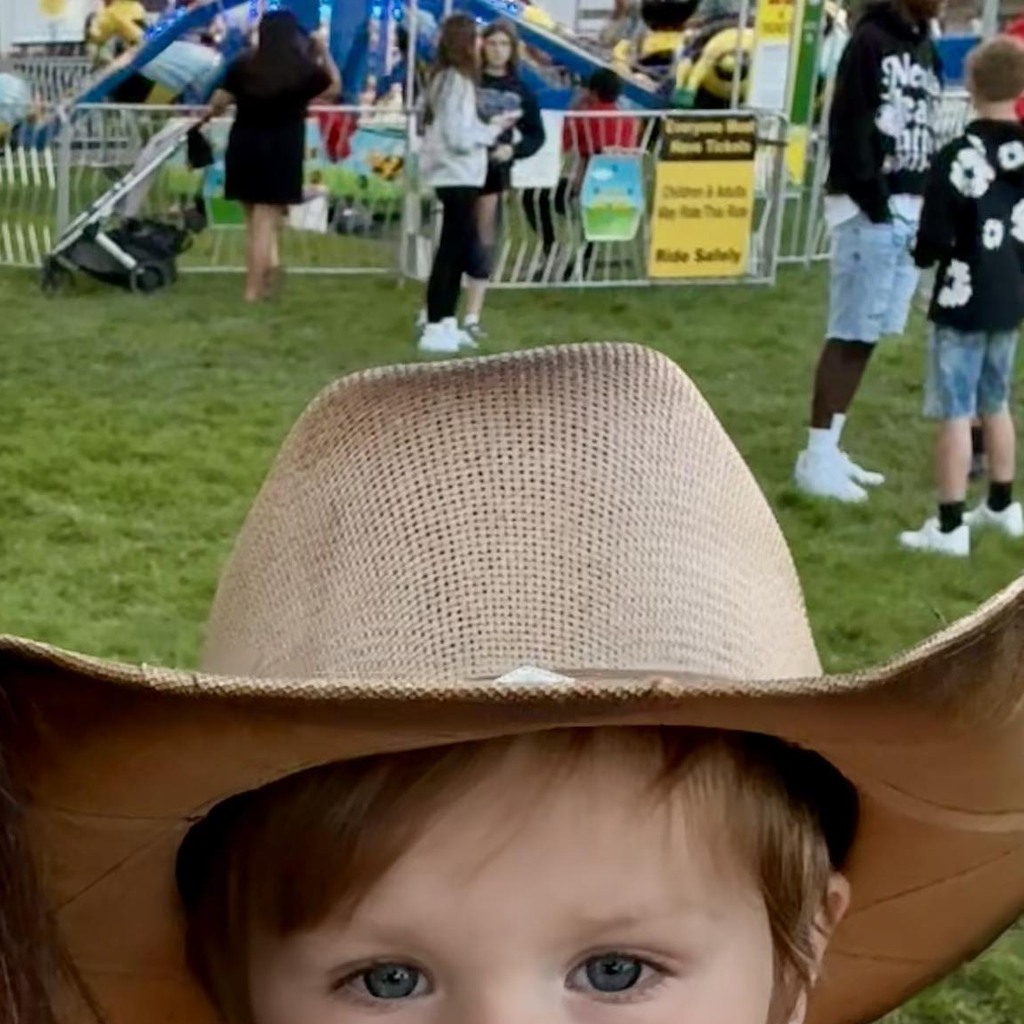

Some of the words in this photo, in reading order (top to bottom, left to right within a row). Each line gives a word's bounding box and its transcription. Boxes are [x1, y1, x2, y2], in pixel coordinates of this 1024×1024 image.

[705, 139, 751, 154] Tickets
[662, 184, 703, 198] Children
[656, 248, 690, 263] Ride
[695, 247, 741, 265] Safely
